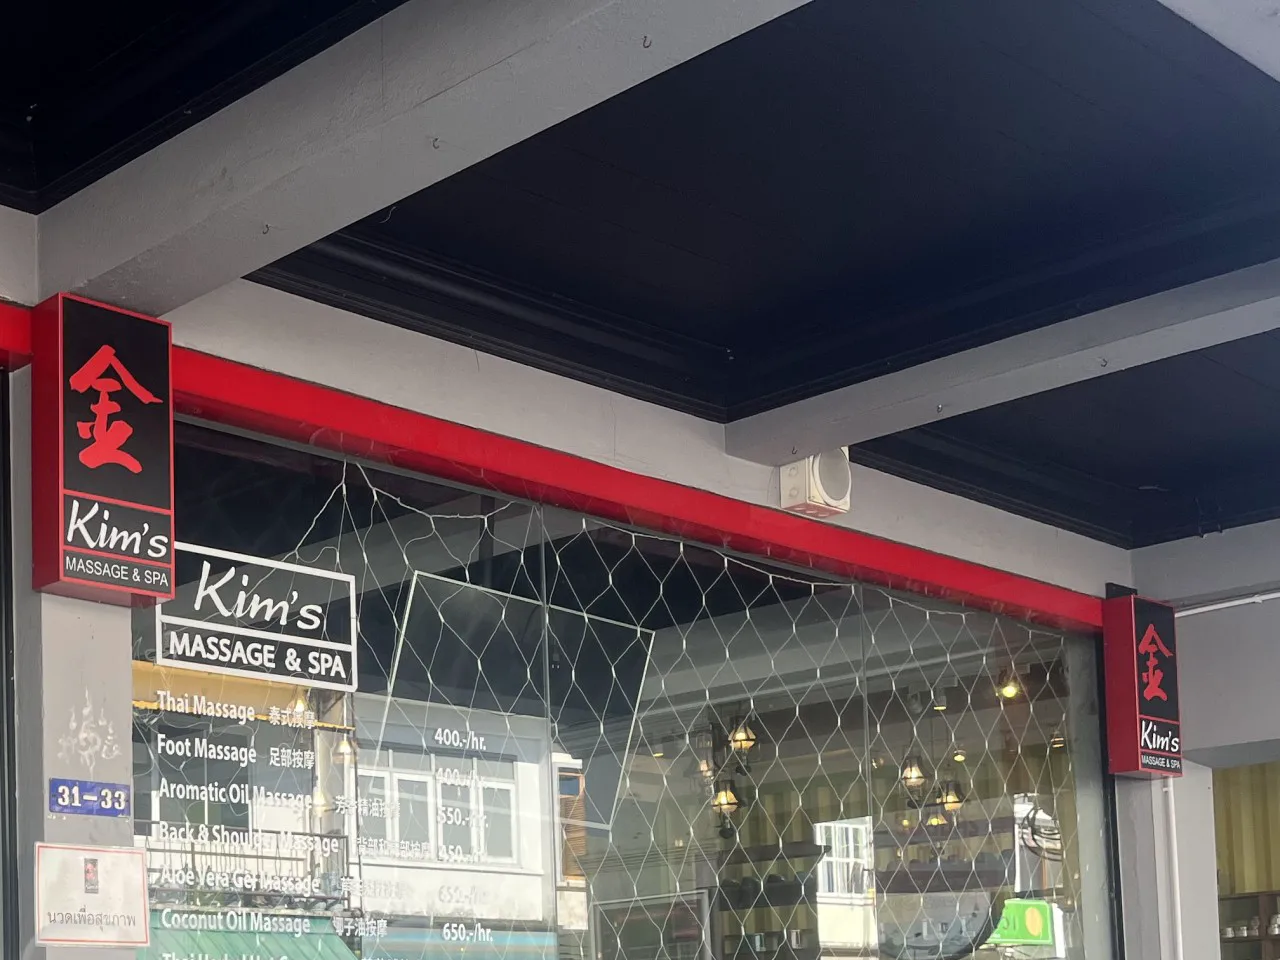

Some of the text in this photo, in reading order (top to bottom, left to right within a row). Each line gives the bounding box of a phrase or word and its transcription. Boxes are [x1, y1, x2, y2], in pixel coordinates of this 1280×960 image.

[69, 344, 164, 475] 金
[67, 499, 169, 559] Kim's
[66, 555, 169, 588] MASSAGE & SPA
[194, 560, 323, 630] Kim's
[169, 631, 347, 679] MASSAGE & SPA
[1138, 623, 1174, 701] 金
[157, 690, 255, 725] Thai Massage
[157, 733, 257, 768] Foot Massage
[434, 727, 487, 751] 400.-/hr.
[1140, 719, 1180, 753] Kim's
[269, 747, 315, 770] 足部按摩
[1141, 754, 1166, 768] MASSAGE
[1171, 759, 1181, 769] SPA
[159, 777, 312, 812] Aromatic Oil Massage
[158, 820, 339, 857] Back & Should Massage
[160, 865, 195, 887] Aloe
[199, 866, 229, 888] Vera
[260, 870, 321, 897] Massage
[47, 904, 137, 932] นวดเพื่อสุขภาพ
[161, 908, 310, 938] Coconut Oil Massage
[443, 922, 493, 943] 650.-/hr.
